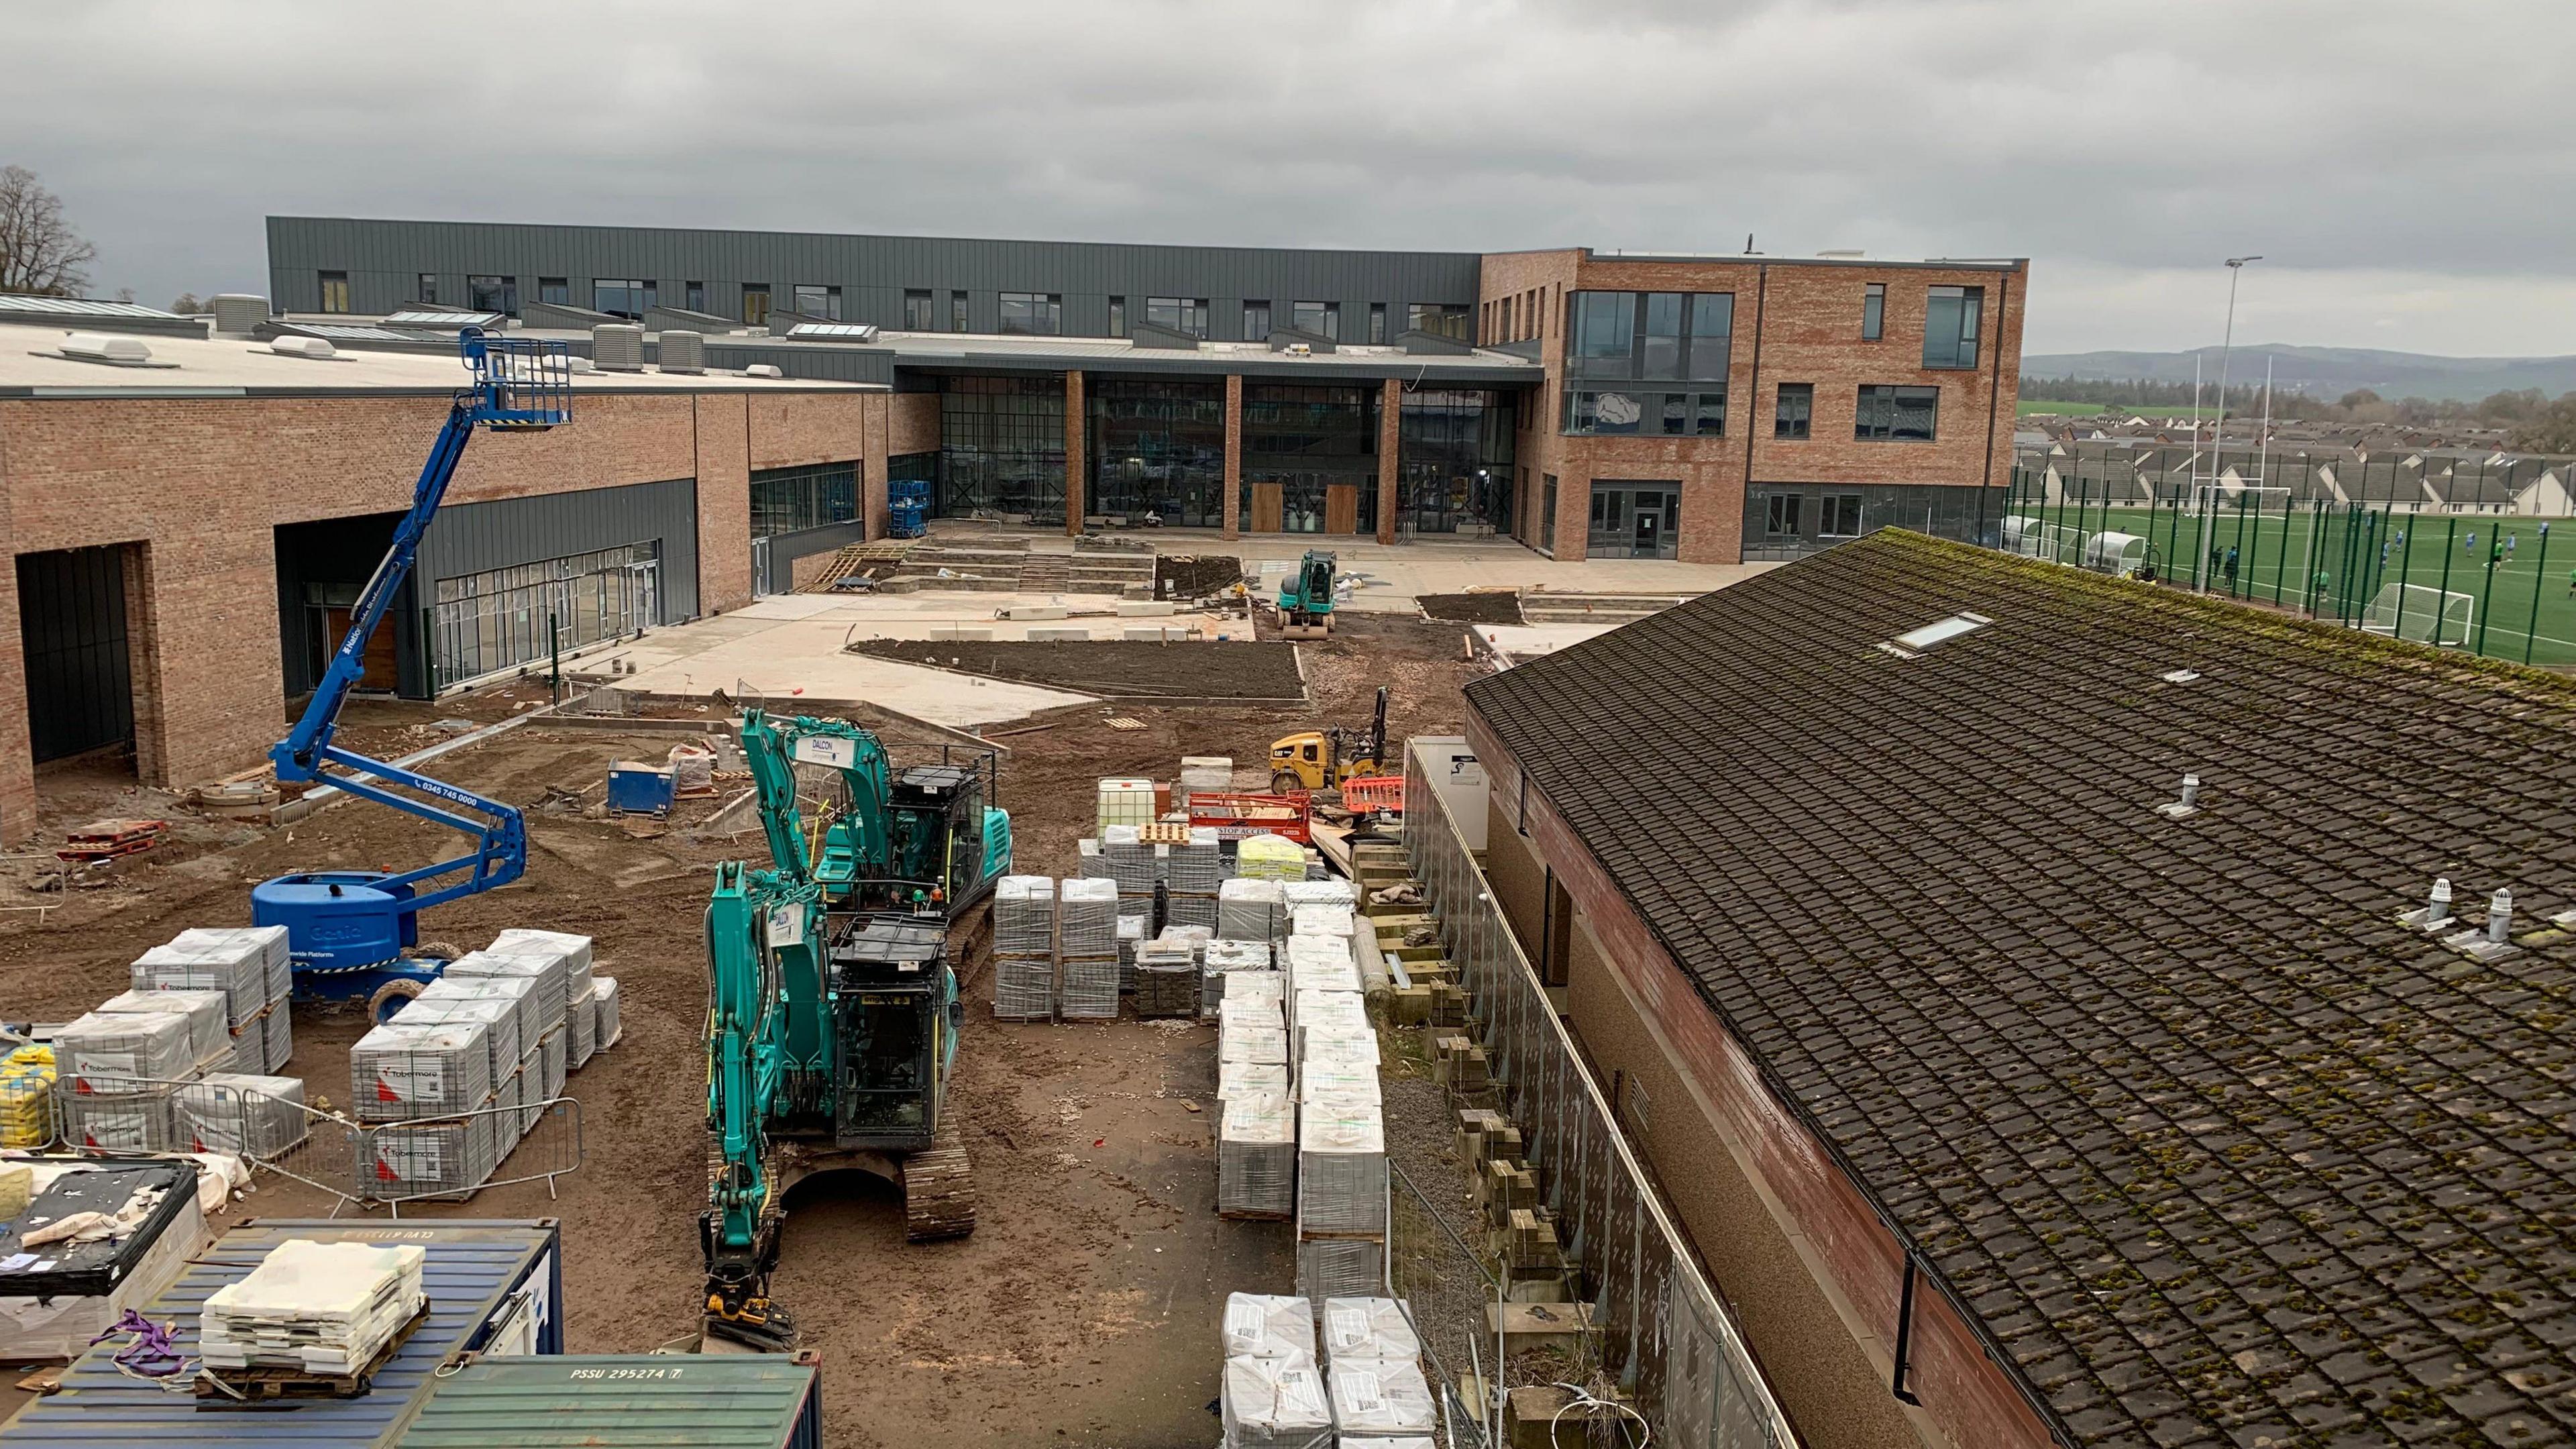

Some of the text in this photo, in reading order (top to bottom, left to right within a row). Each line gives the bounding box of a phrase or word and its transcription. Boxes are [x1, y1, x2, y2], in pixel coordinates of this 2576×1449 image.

[812, 739, 833, 750] DALCON
[423, 782, 477, 806] 0345 745 0000
[570, 1369, 605, 1379] PSSU
[608, 1369, 665, 1379] 295274
